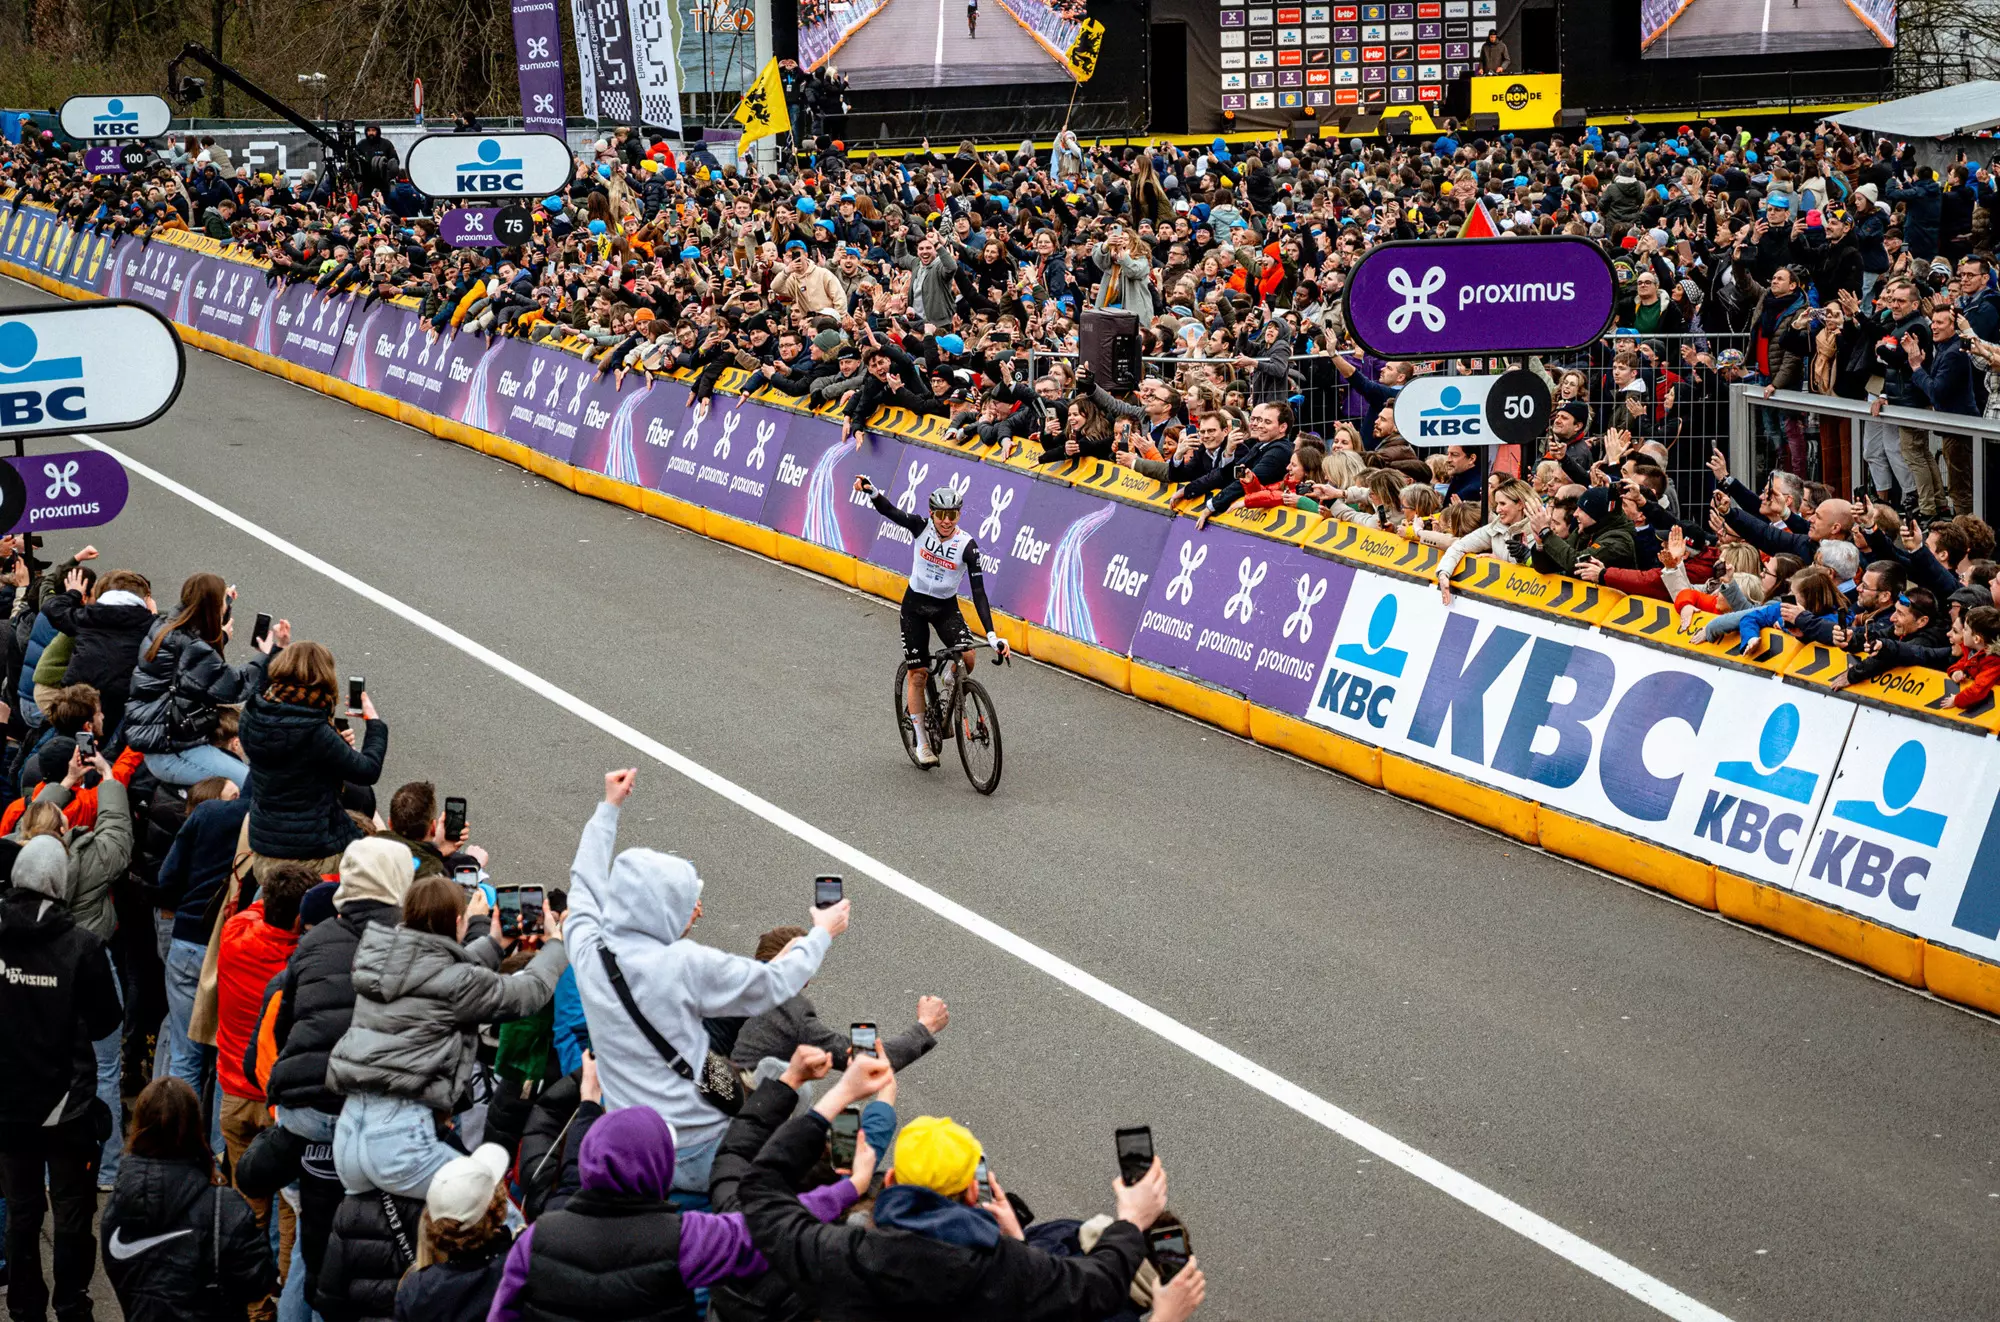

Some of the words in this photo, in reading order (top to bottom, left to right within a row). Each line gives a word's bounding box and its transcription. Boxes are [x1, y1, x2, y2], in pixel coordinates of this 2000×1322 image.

[1492, 94, 1504, 102] DE
[93, 122, 139, 136] KBC
[95, 163, 120, 171] proximus
[124, 153, 143, 164] 100
[456, 174, 523, 192] KBC
[456, 232, 493, 243] proximus
[504, 219, 523, 233] 75
[1459, 282, 1576, 311] proximus
[448, 356, 473, 383] fiber
[496, 370, 521, 398] fiber
[583, 400, 611, 430] fiber
[1503, 395, 1535, 420] 50
[645, 417, 675, 448] fiber
[1420, 419, 1480, 437] KBC
[666, 455, 697, 477] proximus
[696, 464, 730, 488] proximus
[729, 475, 765, 499] proximus
[776, 453, 809, 488] fiber
[1121, 473, 1150, 493] boplan
[29, 502, 100, 524] proximus
[925, 536, 957, 560] UAE
[1011, 525, 1051, 566] fiber
[1360, 535, 1395, 558] boplan
[921, 551, 953, 569] Emirates
[1103, 554, 1149, 598] fiber
[1506, 573, 1547, 598] boplan
[1140, 609, 1194, 641] proximus
[1196, 627, 1254, 662] proximus
[1255, 647, 1315, 682] proximus
[1317, 668, 1396, 729] KBC
[1406, 610, 1714, 822] KBC
[1693, 788, 1804, 865] KBC
[1809, 828, 1932, 911] KBC
